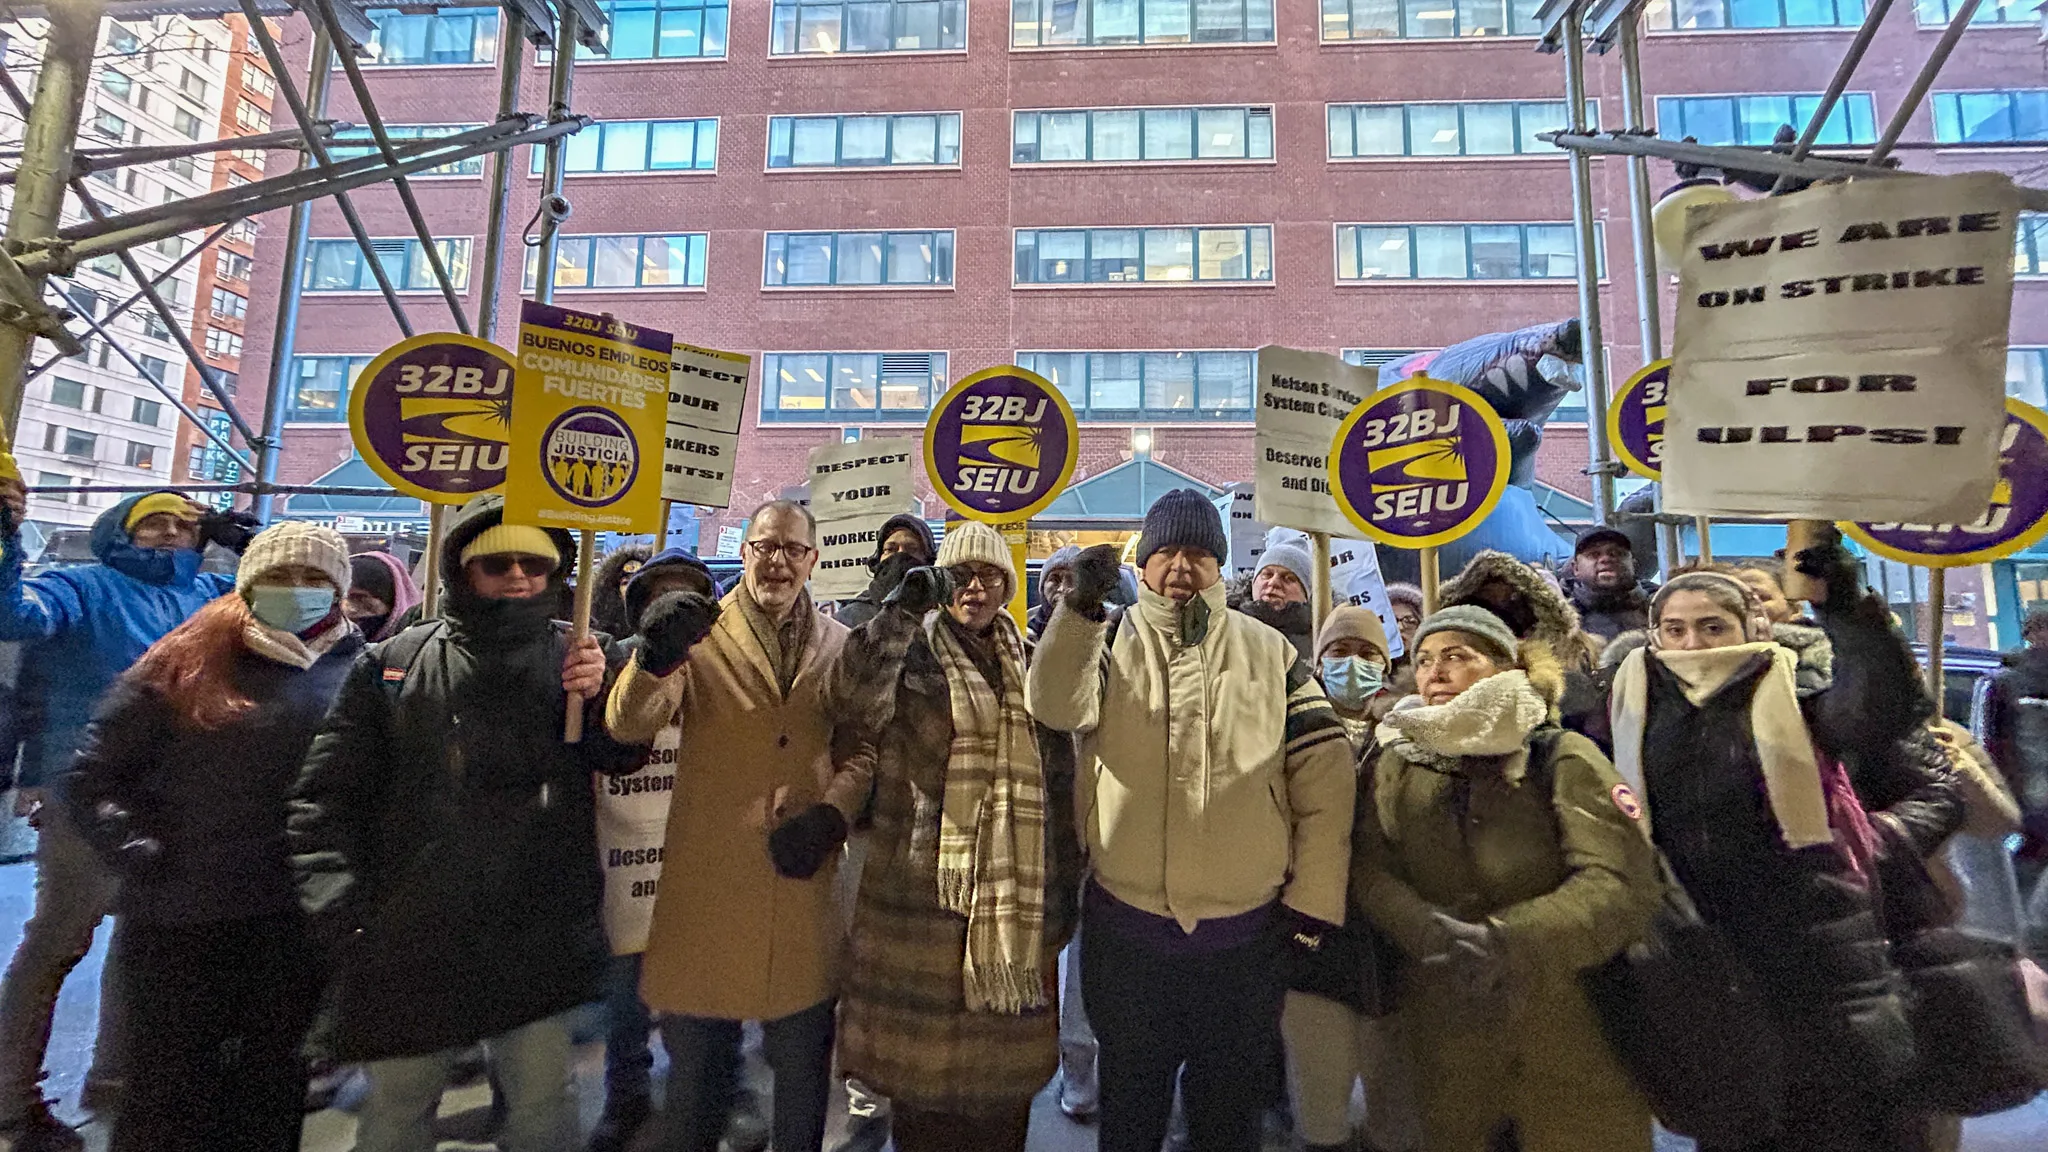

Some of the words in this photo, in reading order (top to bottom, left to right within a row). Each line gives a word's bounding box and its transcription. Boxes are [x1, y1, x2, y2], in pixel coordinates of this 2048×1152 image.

[1698, 226, 1821, 261] WE
[1837, 211, 2000, 244] ARE
[1698, 286, 1766, 308] ON
[1780, 267, 1985, 298] STRIKE
[563, 314, 601, 332] 32BJ
[522, 332, 595, 358] BUENOS
[599, 347, 669, 373] EMPLEOS
[395, 365, 509, 395] 32BJ
[522, 353, 666, 394] COMUNIDADES
[670, 361, 745, 384] SPECT
[543, 375, 646, 409] FUERTES
[1745, 374, 1917, 396] FOR
[668, 391, 720, 412] OUR
[961, 395, 1048, 422] 32BJ
[1264, 392, 1315, 414] System
[1362, 403, 1460, 447] 32BJ
[1697, 425, 1967, 445] ULPS!
[555, 431, 629, 451] BUILDING
[665, 437, 720, 457] RKERS
[402, 445, 509, 472] SEIU
[554, 444, 629, 462] JUSTICIA
[816, 453, 909, 473] RESPECT
[1265, 447, 1322, 469] Deserve
[664, 463, 724, 481] HTS!
[954, 467, 1039, 494] SEIU
[831, 485, 891, 502] YOUR
[1281, 476, 1308, 492] and
[1372, 482, 1469, 520] SEIU
[823, 531, 880, 546] WORKE
